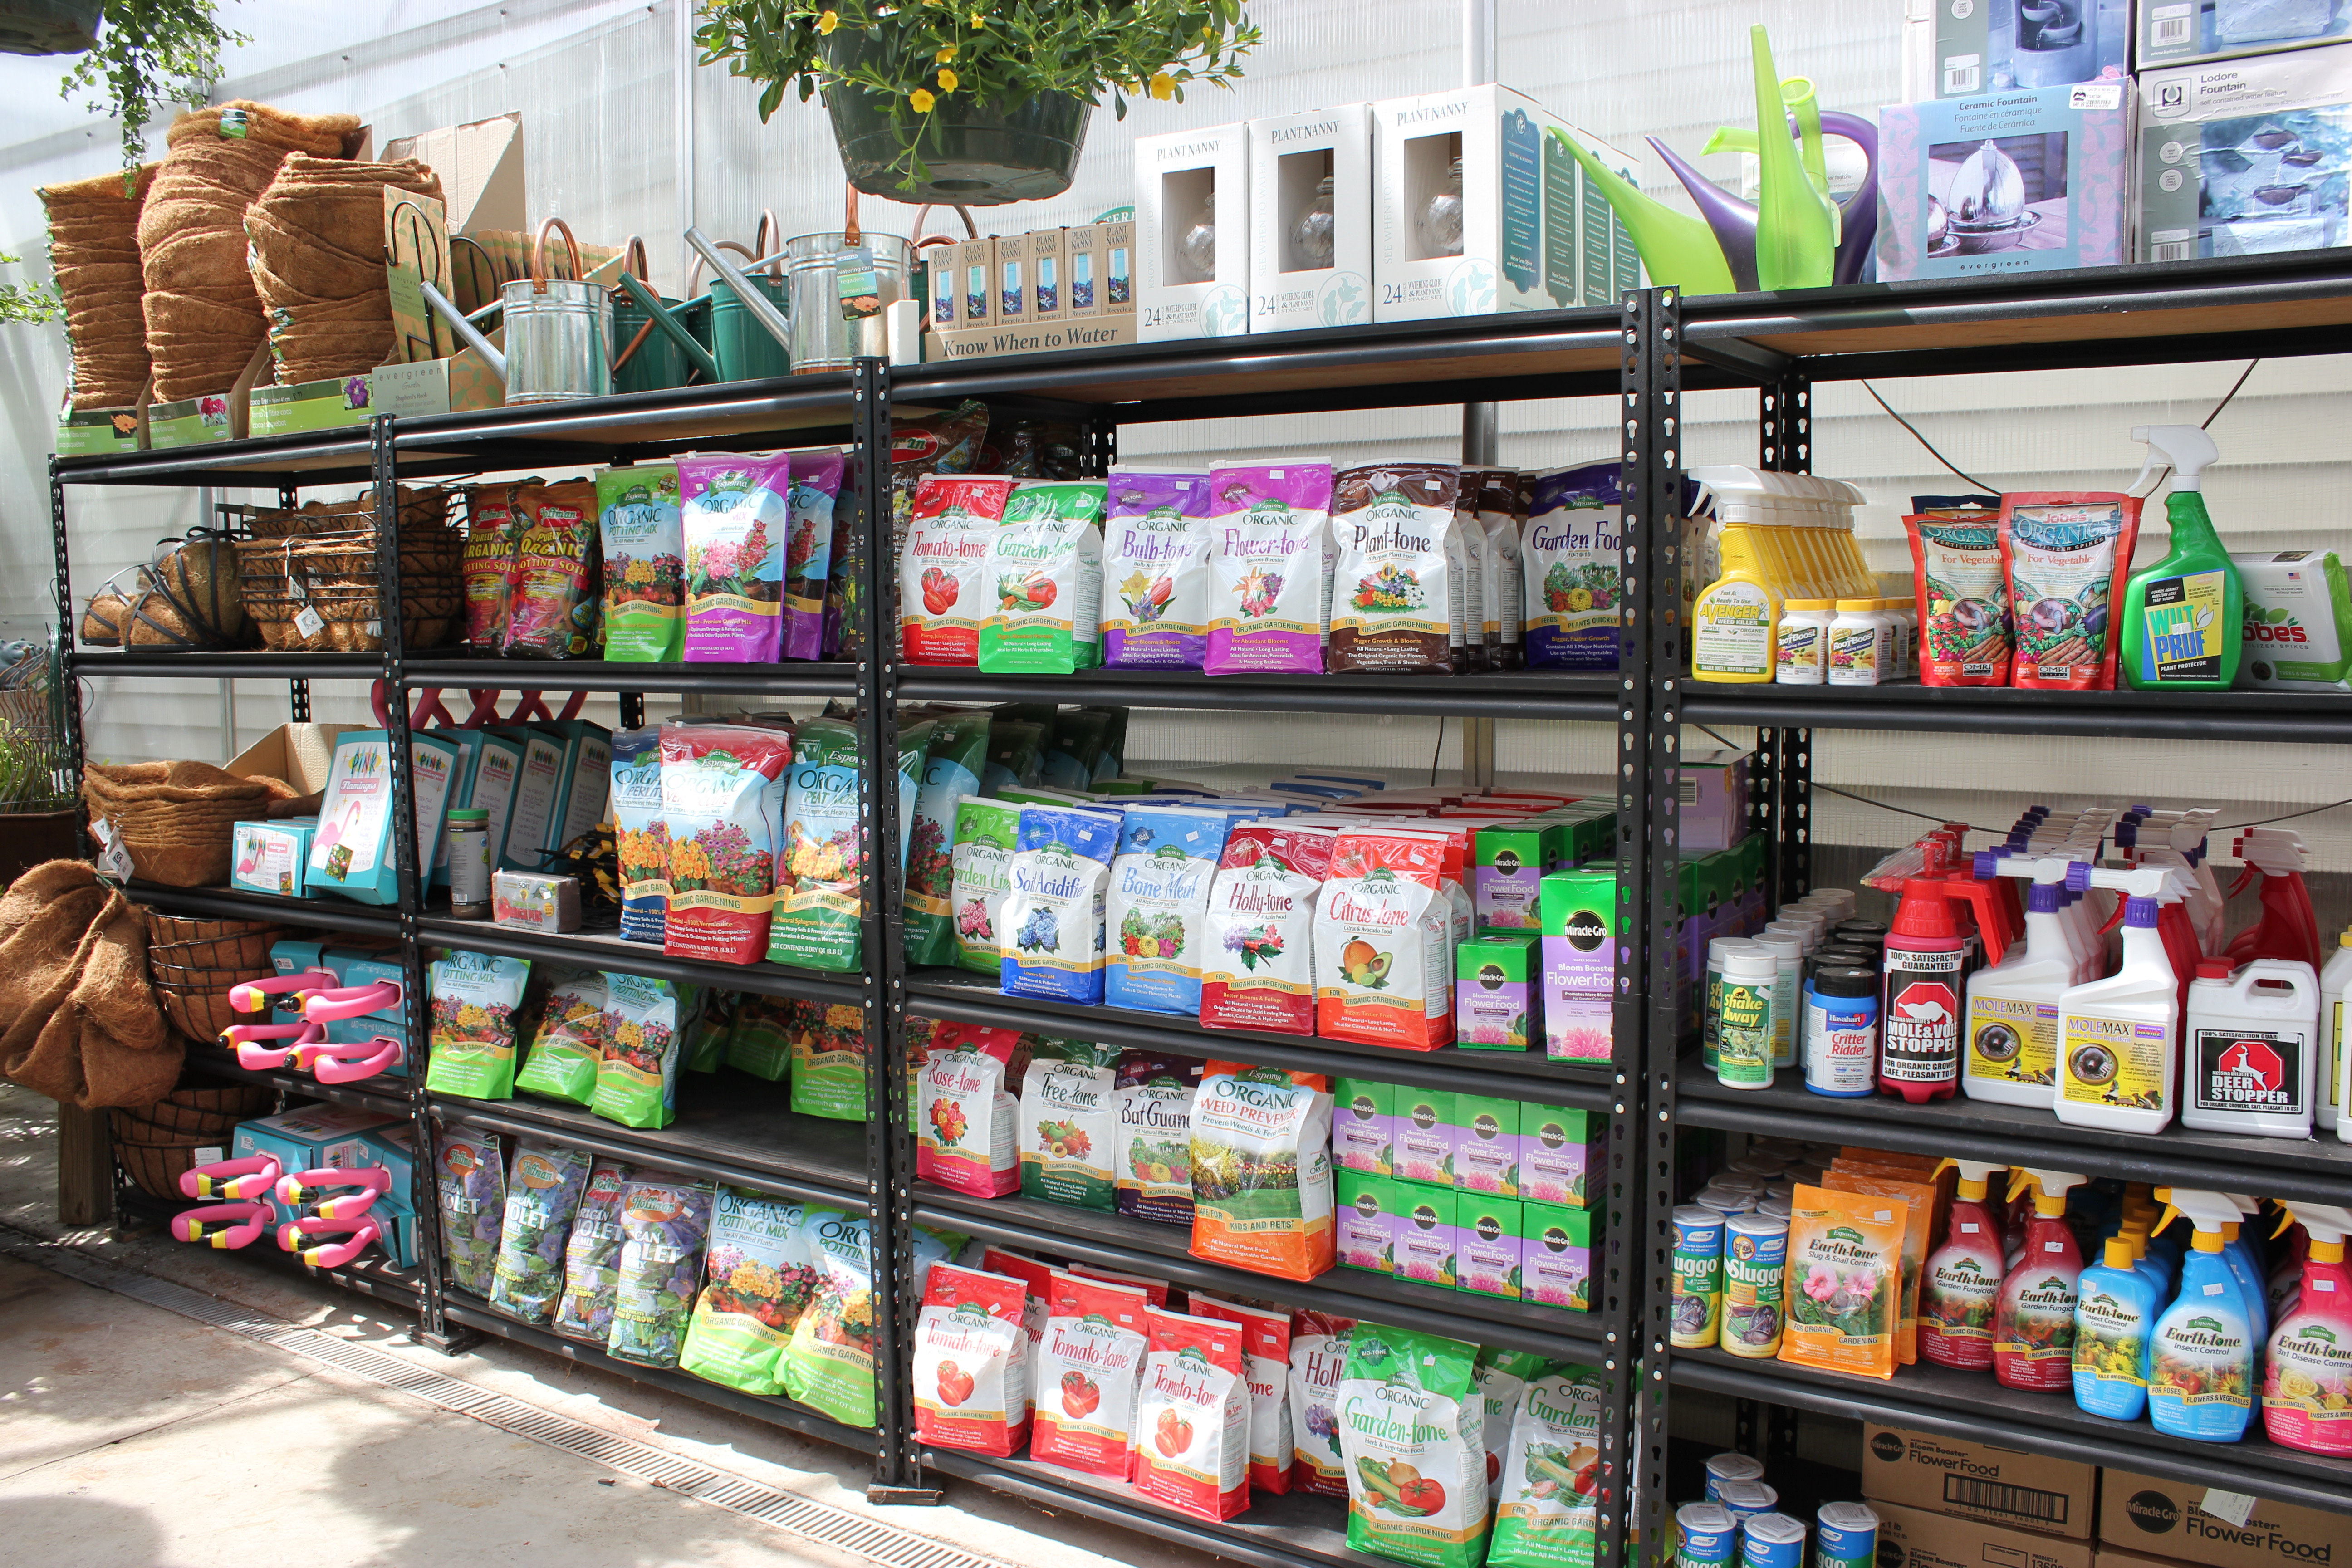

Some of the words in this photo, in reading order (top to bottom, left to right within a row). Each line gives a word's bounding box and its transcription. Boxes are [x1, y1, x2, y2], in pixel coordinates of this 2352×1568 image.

[2200, 71, 2238, 83] Lodore
[2200, 82, 2246, 95] Fountain
[1959, 102, 1994, 111] Ceramic
[1997, 96, 2037, 107] Fountain
[2213, 95, 2244, 103] contained
[1955, 113, 1988, 122] Fontaine
[2001, 107, 2042, 118] céramique
[1271, 126, 1303, 144] PLANT
[1304, 120, 1340, 139] NANNY
[1960, 123, 1986, 133] Fuente
[1987, 121, 1997, 130] de
[1999, 119, 2035, 129] Cerámica
[1157, 144, 1187, 161] PLANT
[1188, 140, 1220, 157] NANNY
[1107, 225, 1128, 237] PLANT
[1106, 235, 1129, 246] NANNY
[965, 244, 984, 255] PLANT
[965, 253, 985, 264] NANNY
[1960, 259, 2030, 270] evergreen
[1408, 280, 1428, 289] WATERING
[1429, 278, 1443, 287] GLOBE
[1383, 284, 1402, 304] 24
[1258, 296, 1275, 315] 24
[944, 340, 988, 357] Know
[993, 333, 1039, 351] When
[1045, 332, 1061, 347] to
[1067, 328, 1118, 344] Water
[379, 367, 441, 381] evergreen
[715, 478, 748, 490] Espoma
[608, 507, 662, 526] ORGANIC
[1242, 514, 1298, 526] ORGANIC
[471, 531, 494, 543] PURELY
[608, 524, 641, 536] POTTING
[643, 524, 657, 534] MIX
[1532, 522, 1588, 553] Garden
[2017, 518, 2110, 544] ORGANICS
[911, 531, 985, 558] Tomato-tone
[1122, 531, 1192, 560] Bulb-tone
[1223, 528, 1308, 557] Flower-tone
[1353, 525, 1431, 554] Plant-tone
[2023, 539, 2071, 551] FERTILIZER
[2075, 538, 2104, 550] SPIKES
[2027, 554, 2044, 563] For
[2047, 555, 2096, 566] Vegetables
[494, 562, 517, 576] SOIL
[1700, 603, 1759, 625] AVENGER
[1236, 623, 1263, 634] ORGANIC
[1264, 621, 1303, 631] GARDENING
[1568, 621, 1590, 629] PLANTS
[1592, 617, 1618, 627] QUICKLY
[2154, 630, 2205, 662] PRUF
[2160, 664, 2176, 672] PLANT
[2178, 661, 2206, 669] PROTECTOR
[1035, 854, 1079, 871] ORGANIC
[1013, 867, 1034, 894] Soil
[1034, 871, 1086, 898] Acidifier
[1122, 867, 1162, 898] Bone
[1352, 882, 1402, 895] ORGANIC
[1229, 882, 1293, 913] Holly-tone
[1330, 892, 1409, 926] Citrus-tone
[1891, 951, 1910, 961] 100%
[1912, 952, 1961, 962] SATISFACTION
[1131, 963, 1154, 971] ORGANIC
[1155, 962, 1188, 975] GARDENING
[1902, 961, 1953, 970] GUARANTEED
[1723, 1007, 1759, 1026] Away
[2068, 1019, 2131, 1036] MOLEMAX
[1831, 1033, 1867, 1044] Critter
[1831, 1044, 1867, 1055] Ridder
[928, 1058, 981, 1094] Rose-tone
[1054, 1063, 1099, 1081] ORGANIC
[1247, 1068, 1282, 1084] Espoma
[1042, 1072, 1098, 1108] Tree-tone
[2212, 1076, 2253, 1089] DEER
[1215, 1080, 1299, 1110] ORGANIC
[2211, 1088, 2288, 1104] STOPPER
[1122, 1098, 1144, 1125] Bat
[1200, 1096, 1239, 1114] WEED
[1241, 1103, 1298, 1123] PREVENTER
[719, 1195, 802, 1227] ORGANIC
[717, 1214, 762, 1236] POTTING
[764, 1224, 789, 1240] MIX
[1230, 1220, 1248, 1230] KIDS
[1250, 1220, 1265, 1230] AND
[1268, 1219, 1293, 1230] PETS
[1808, 1238, 1879, 1260] Earth-tone
[1808, 1251, 1823, 1260] Slug
[1833, 1254, 1849, 1263] Snail
[1851, 1255, 1876, 1268] Control
[1730, 1259, 1784, 1287] Sluggo
[1937, 1280, 1961, 1289] Garden
[1963, 1284, 1995, 1294] Fungicide
[1793, 1323, 1803, 1332] FOR
[1805, 1325, 1833, 1334] ORGANIC
[928, 1318, 1000, 1357] Tomato-tone
[1838, 1336, 1877, 1345] GARDENING
[2165, 1327, 2241, 1348] Earth-tone
[1050, 1328, 1129, 1369] Tomato-tone
[2278, 1348, 2289, 1357] 3n1
[2291, 1351, 2322, 1364] Disease
[1375, 1387, 1430, 1410] ORGANIC
[2164, 1387, 2182, 1396] ROSES,
[2219, 1395, 2249, 1405] VEGETABLES
[1345, 1395, 1448, 1444] Garden-tone
[1383, 1440, 1409, 1452] Vegetable
[1910, 1441, 1932, 1452] Bloom
[1934, 1445, 1966, 1458] Booster
